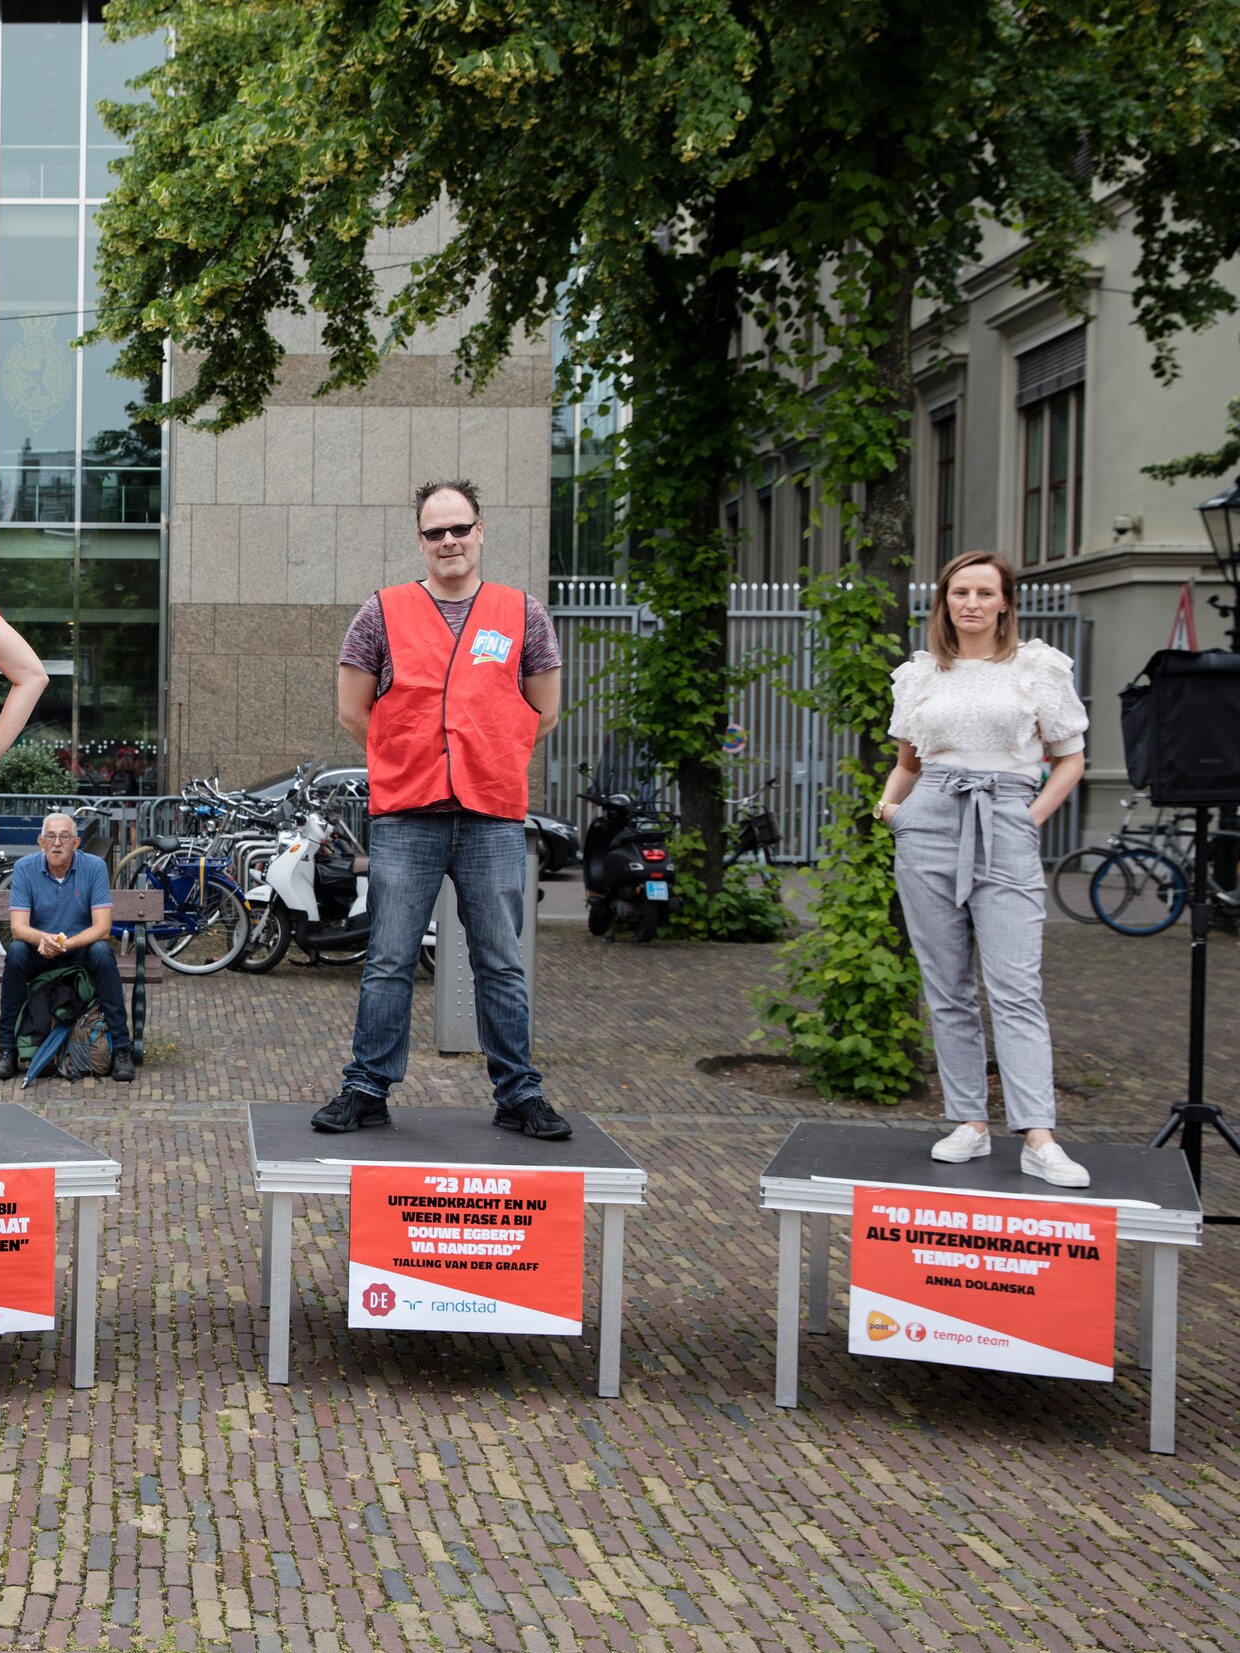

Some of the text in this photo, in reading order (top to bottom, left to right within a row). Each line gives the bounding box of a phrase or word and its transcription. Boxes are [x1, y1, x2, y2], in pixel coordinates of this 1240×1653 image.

[475, 636, 510, 654] FNV
[463, 1178, 511, 1195] JAAR
[388, 1195, 547, 1211] UITZENDKRACHT EN NU
[402, 1211, 532, 1226] WEER IN FASE A BIJ
[914, 1208, 968, 1229] JAAR
[972, 1213, 1003, 1233] BIJ
[1007, 1217, 1096, 1242] POSTNL
[408, 1226, 525, 1242] DOUWE EGBERTS
[411, 1241, 435, 1254] VIA
[866, 1226, 1100, 1261] ALS UITZENDKRACHT VIA
[393, 1258, 539, 1272] TJALLING VAN DER GRAAFF
[912, 1249, 979, 1269] TEMPO
[925, 1275, 1035, 1296] ANNA DOLANSKA
[431, 1299, 497, 1314] randstad
[933, 1330, 973, 1344] tempo
[977, 1334, 1010, 1347] team
